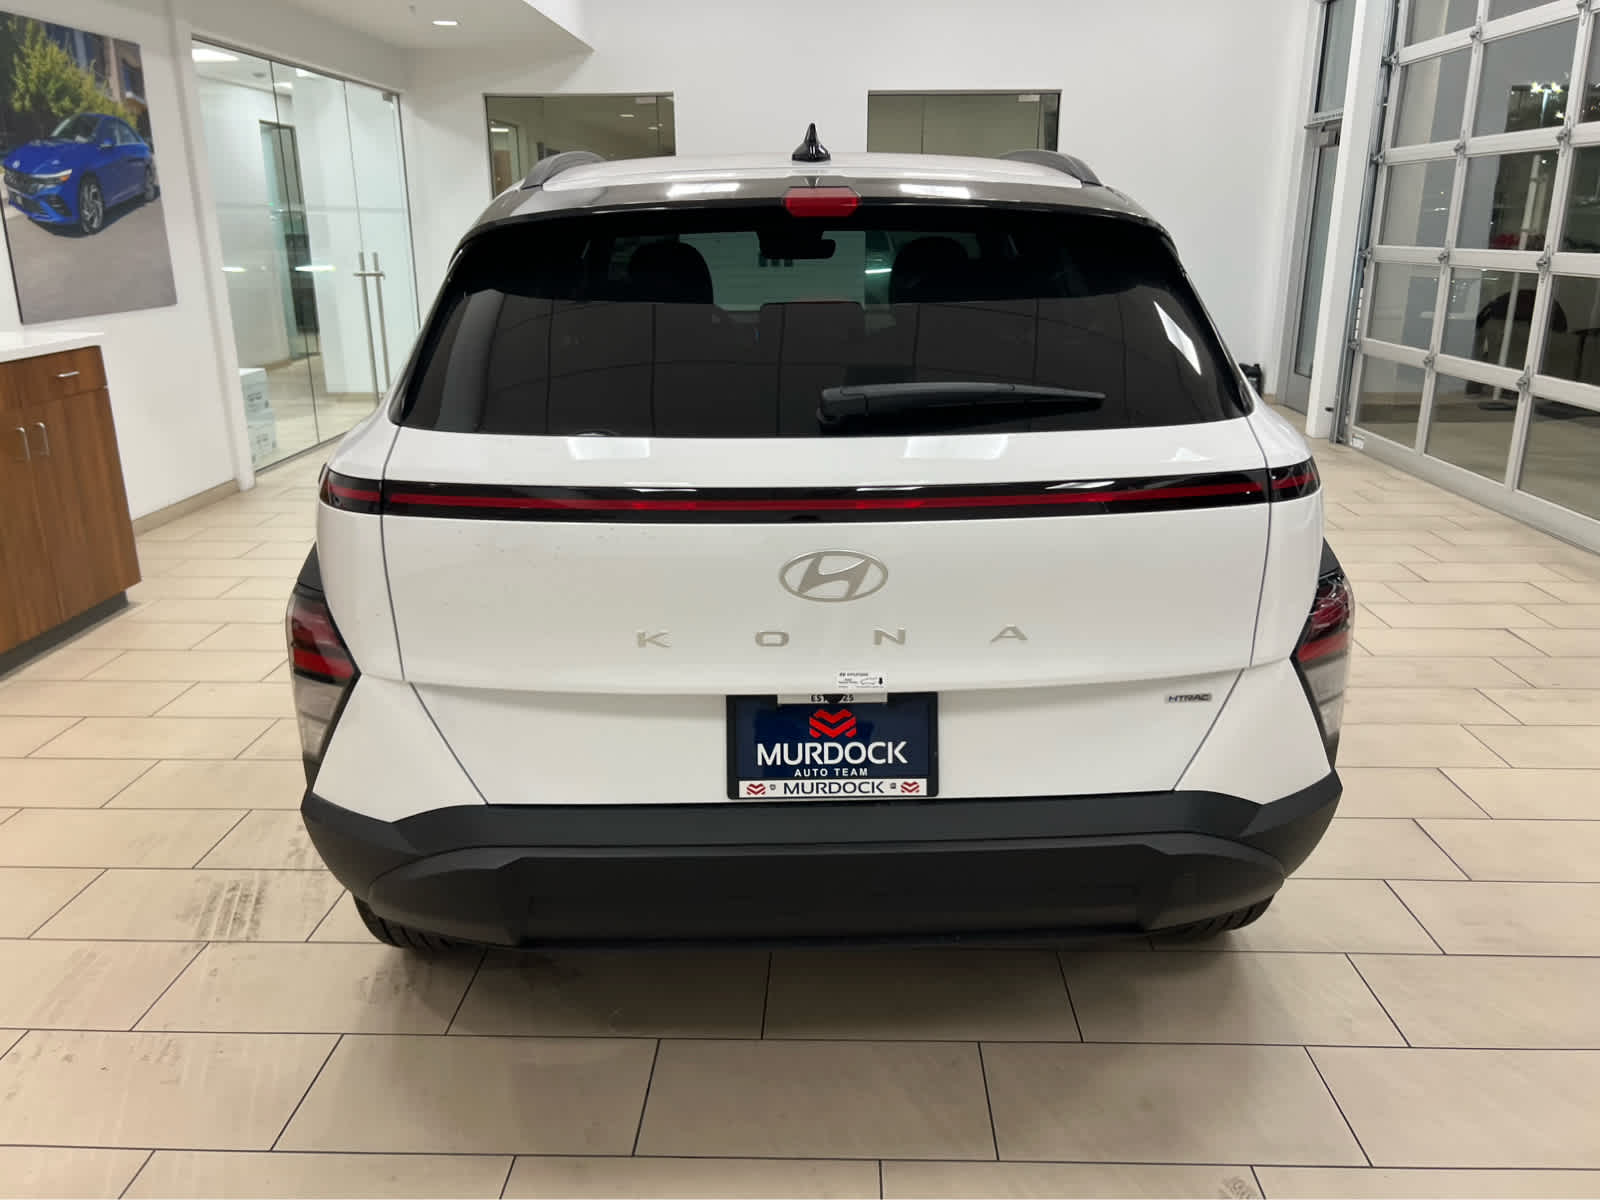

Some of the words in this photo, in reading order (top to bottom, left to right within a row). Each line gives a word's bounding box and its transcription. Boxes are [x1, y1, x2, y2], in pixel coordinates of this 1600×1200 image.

[636, 624, 1028, 648] KONA
[1167, 694, 1210, 703] HTRAC
[757, 741, 908, 766] MURDOCK
[794, 768, 829, 777] AUTO
[834, 767, 868, 776] TEAM
[783, 781, 885, 795] MURDOCK
